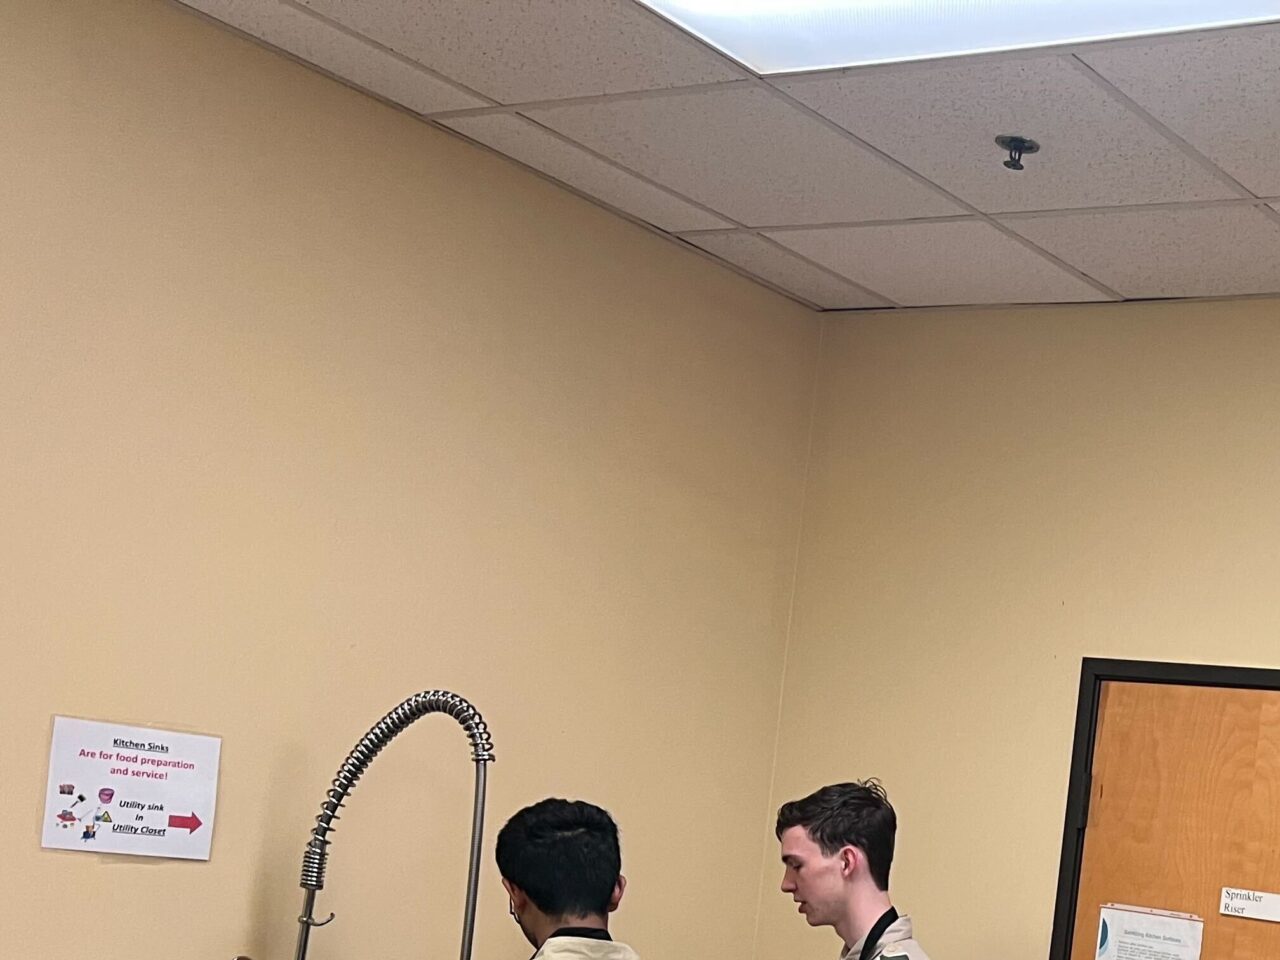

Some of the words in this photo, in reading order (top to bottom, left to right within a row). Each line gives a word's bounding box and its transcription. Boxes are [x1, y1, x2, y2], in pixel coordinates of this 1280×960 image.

[113, 738, 146, 750] Kitchen
[148, 742, 169, 752] Sinks
[79, 749, 96, 759] Are
[99, 750, 113, 760] for
[116, 752, 138, 763] food
[140, 756, 195, 770] preparation
[110, 767, 128, 776] and
[131, 769, 168, 780] service!
[119, 799, 145, 811] Utility
[147, 803, 164, 811] sink
[112, 823, 139, 834] Utility
[140, 826, 167, 836] Closet
[1224, 888, 1264, 904] Sprinkler
[1224, 902, 1246, 914] Riser
